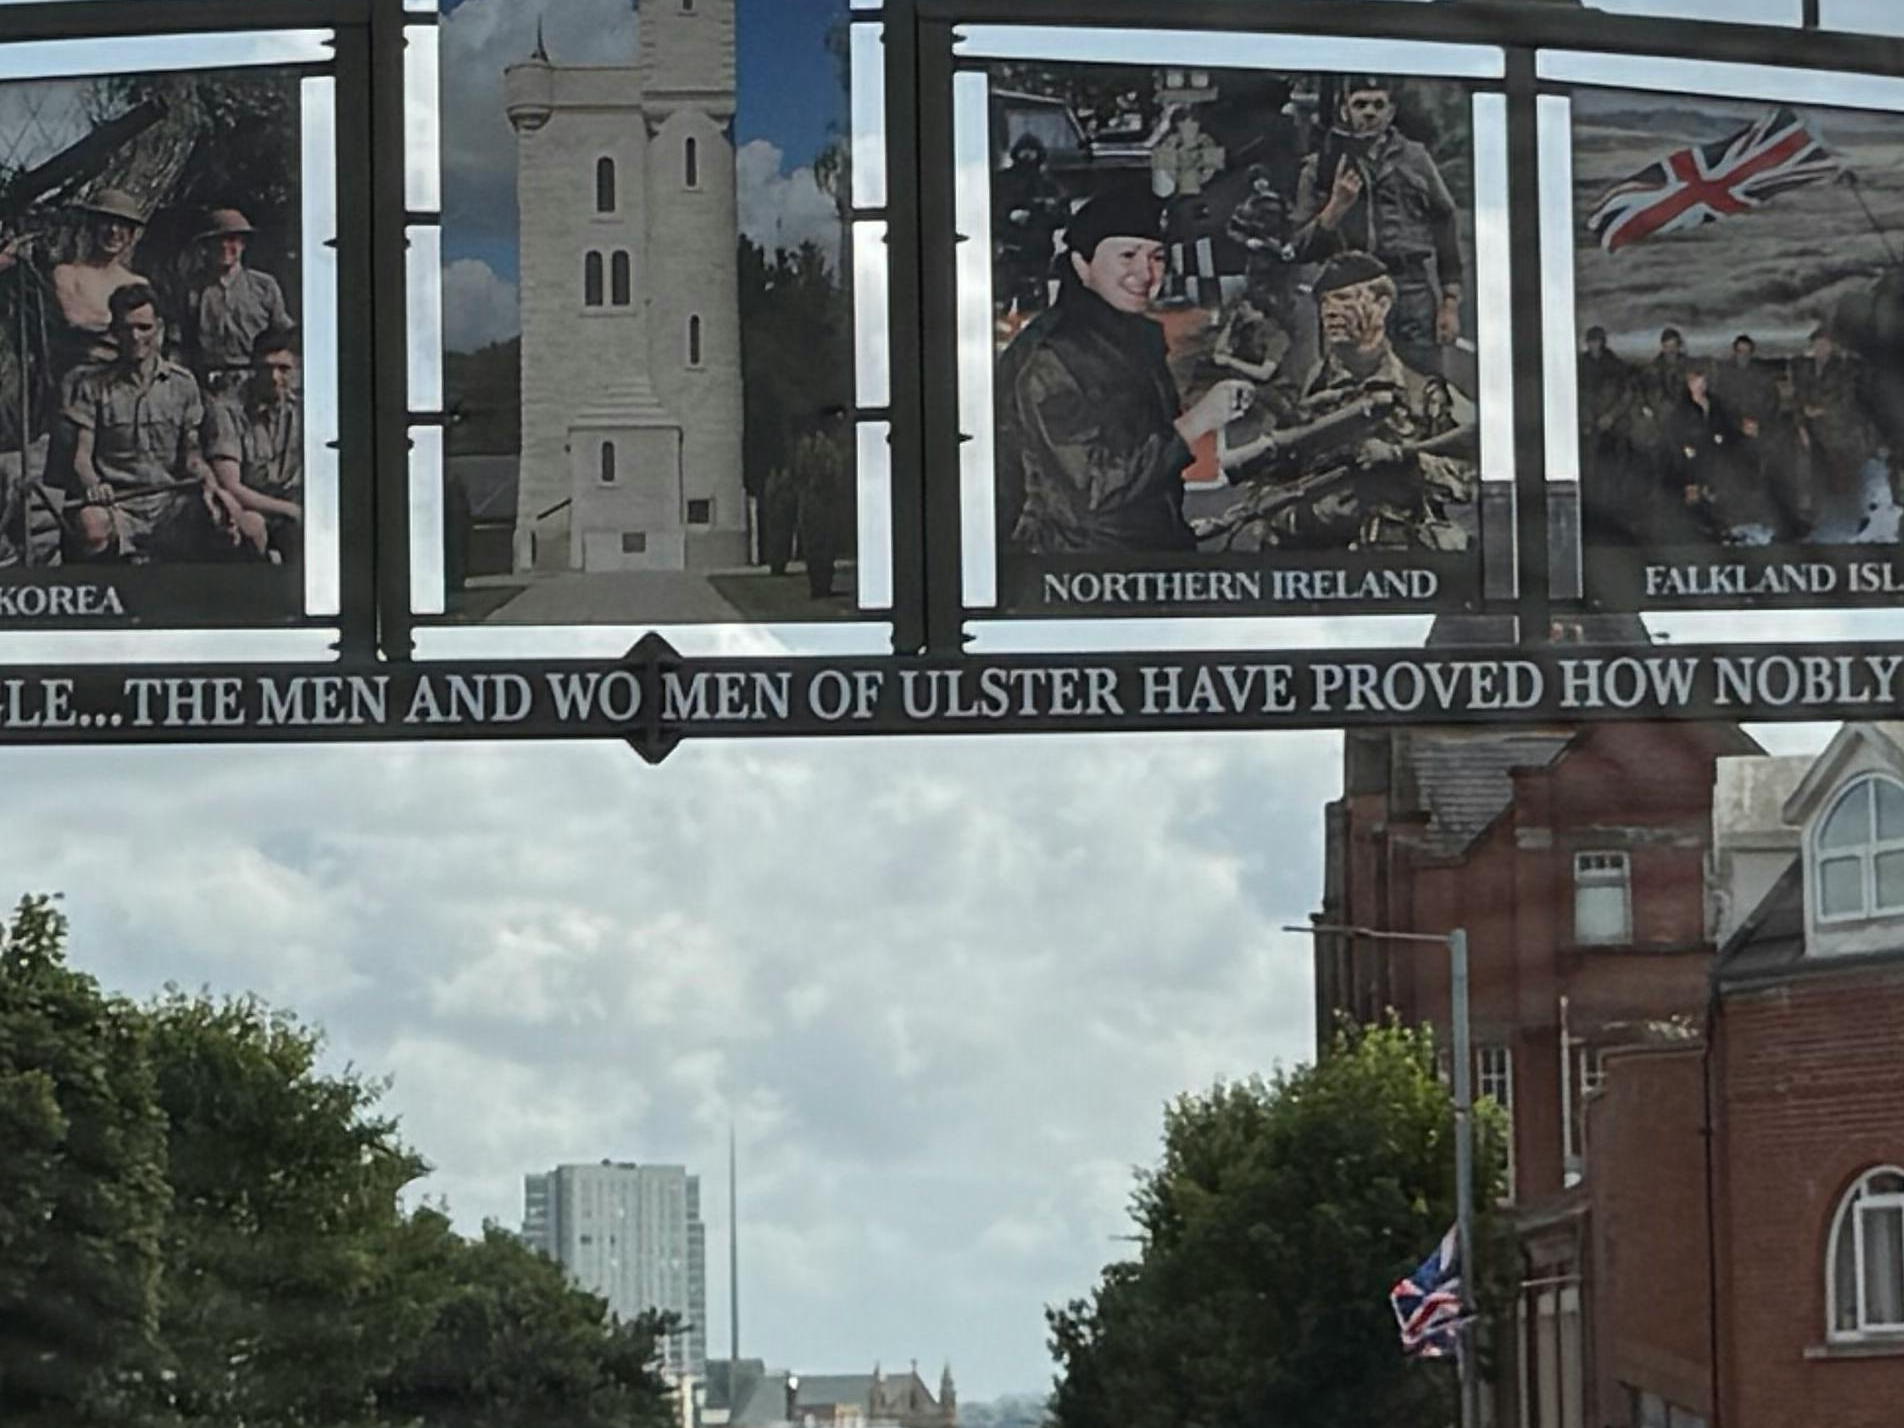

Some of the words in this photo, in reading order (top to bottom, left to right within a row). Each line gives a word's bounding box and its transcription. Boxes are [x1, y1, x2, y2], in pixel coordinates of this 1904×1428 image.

[1044, 571, 1261, 603] NORTHERN
[1272, 569, 1438, 601] IRELAND
[1645, 563, 1837, 596] FALKLAND
[257, 675, 390, 726] MEN
[403, 673, 532, 724] AND
[808, 670, 885, 720] OF
[900, 667, 1124, 719] ULSTER
[1139, 664, 1294, 715] HAVE
[1309, 659, 1545, 713] PROVED
[1559, 658, 1700, 708] HOW
[1713, 655, 1904, 706] NOBLY
